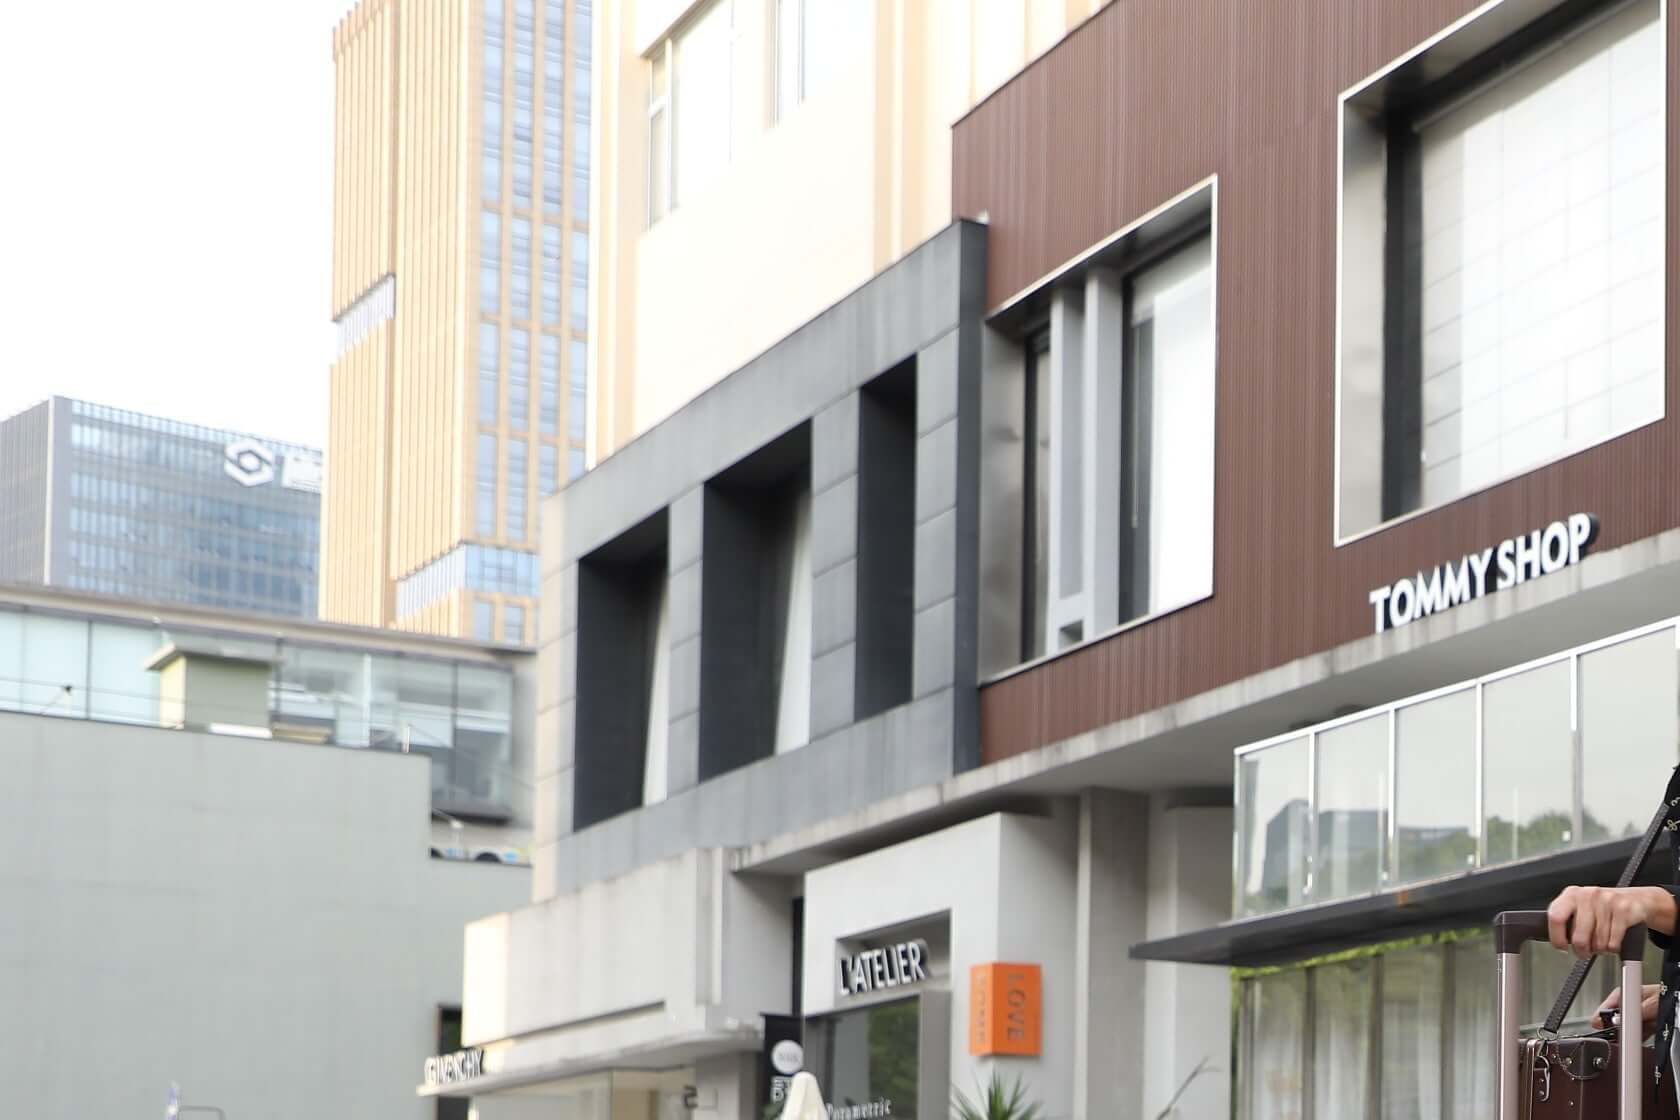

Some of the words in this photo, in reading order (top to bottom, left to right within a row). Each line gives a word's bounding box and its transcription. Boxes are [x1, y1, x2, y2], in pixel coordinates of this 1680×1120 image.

[1369, 545, 1494, 634] TOMMY
[1495, 512, 1596, 590] SHOP
[840, 941, 926, 995] L'ATELIER
